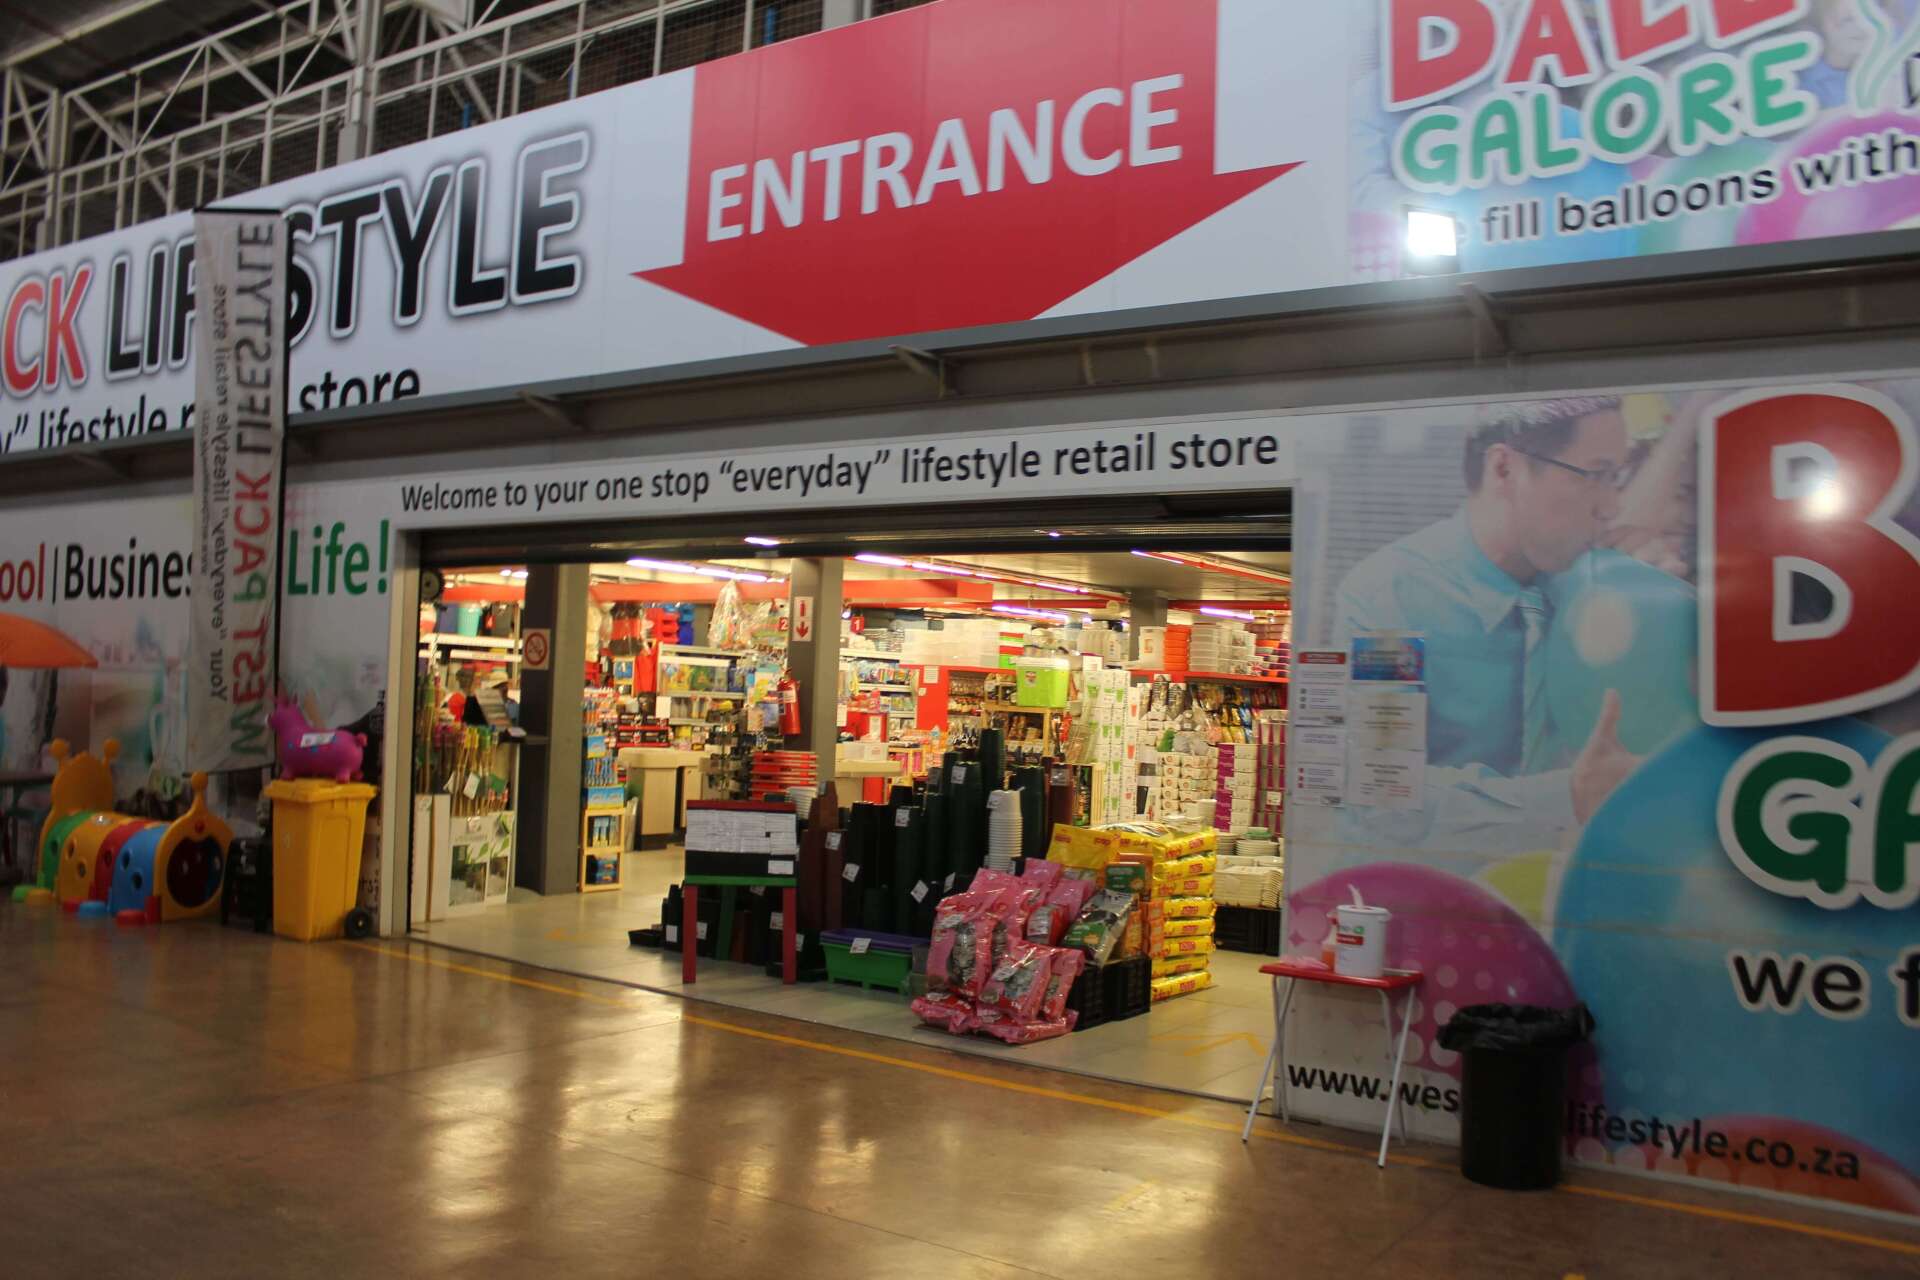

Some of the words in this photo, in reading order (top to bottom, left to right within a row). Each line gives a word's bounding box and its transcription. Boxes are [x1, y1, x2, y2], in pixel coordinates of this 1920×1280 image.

[1402, 42, 1808, 186] GALORE
[706, 73, 1184, 243] ENTRANCE
[1482, 201, 1538, 242] fill
[1559, 166, 1776, 232] balloons
[1796, 134, 1920, 190] with
[107, 145, 577, 374] LIFSTYLE
[299, 368, 420, 412] store
[402, 482, 498, 512] Welcome
[504, 479, 528, 507] to
[535, 478, 589, 511] your
[596, 475, 643, 501] one
[651, 467, 711, 502] stop
[901, 440, 1041, 488] lifestyle
[1053, 431, 1156, 476] retail
[1169, 433, 1278, 470] store
[63, 537, 193, 602] Busine
[288, 519, 390, 597] Life!
[1732, 955, 1862, 1013] we
